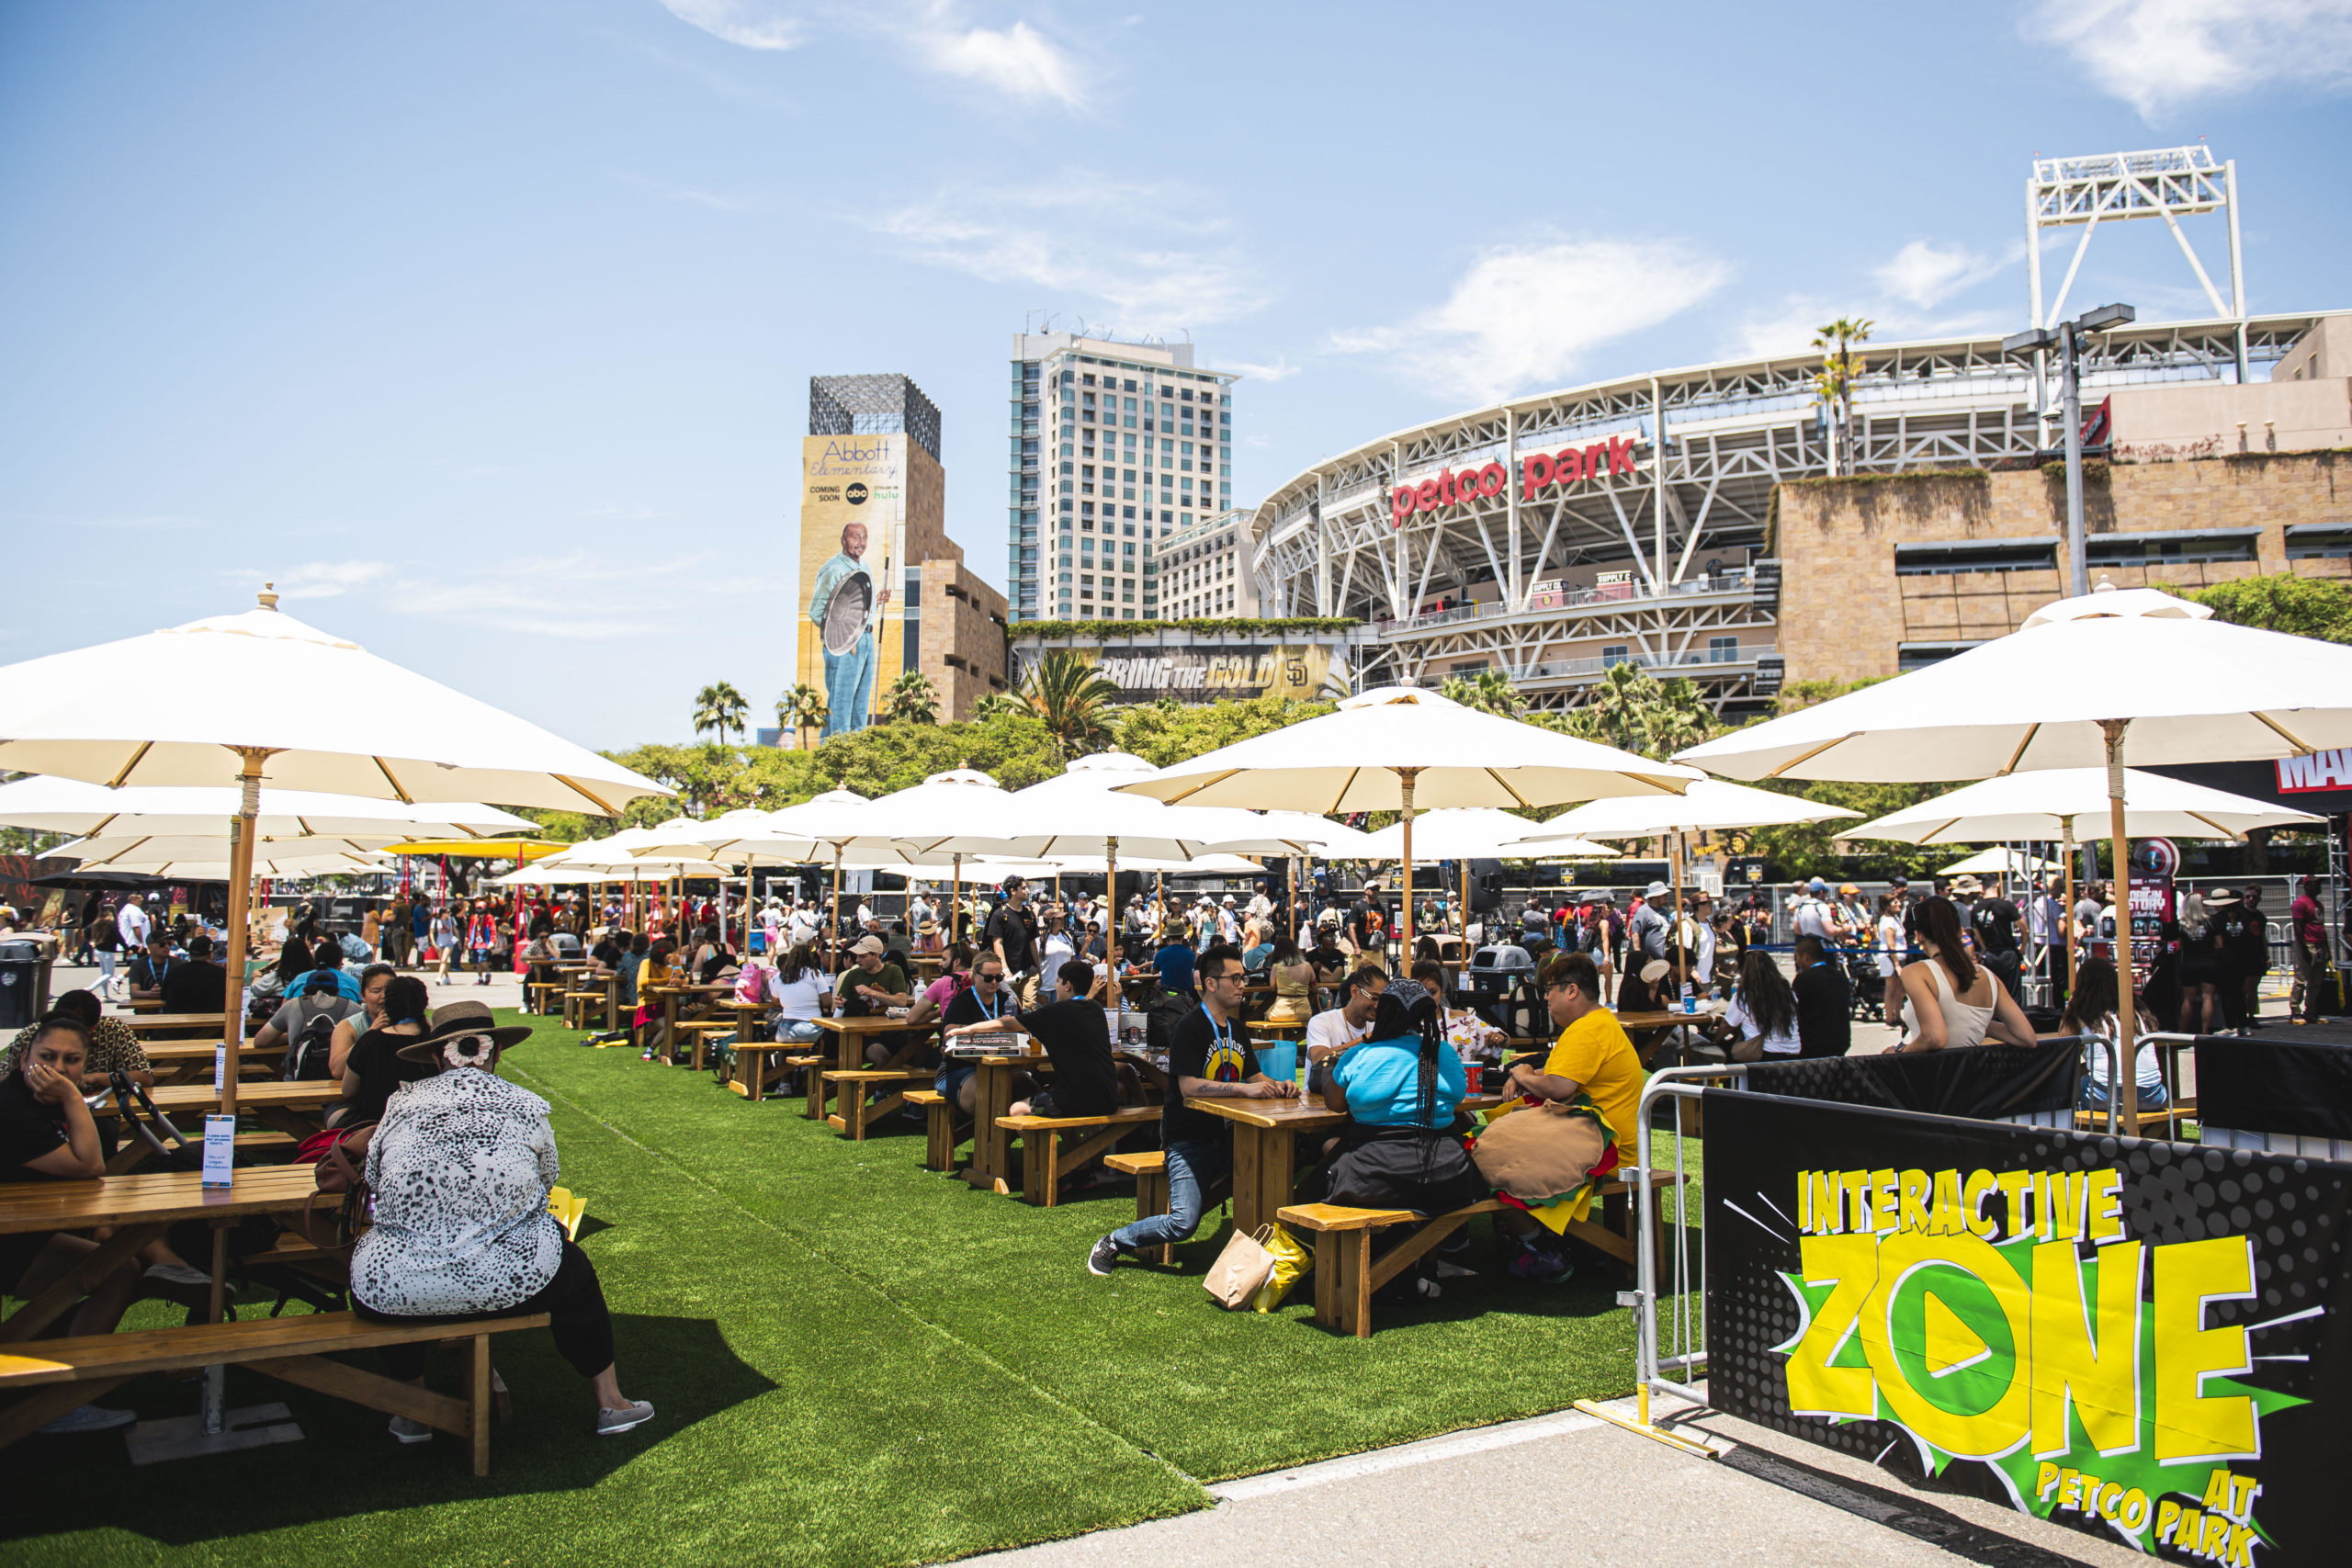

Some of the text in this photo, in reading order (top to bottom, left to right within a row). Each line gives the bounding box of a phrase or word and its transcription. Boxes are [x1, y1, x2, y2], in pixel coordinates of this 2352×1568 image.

[822, 440, 890, 461] Abbott
[809, 461, 898, 479] Elementary
[1392, 435, 1636, 528] petco park
[819, 494, 841, 502] SOON
[846, 488, 868, 499] abc
[874, 490, 899, 500] hulu
[1091, 657, 1277, 689] BRING THE GOLD
[2128, 898, 2165, 910] STORY
[2129, 890, 2163, 899] ORIGIN
[1797, 1168, 2125, 1245] INTERACTIVE
[1785, 1229, 2261, 1466] ZONE
[2201, 1468, 2262, 1528] AT
[2035, 1461, 2263, 1568] PETCO PARK
